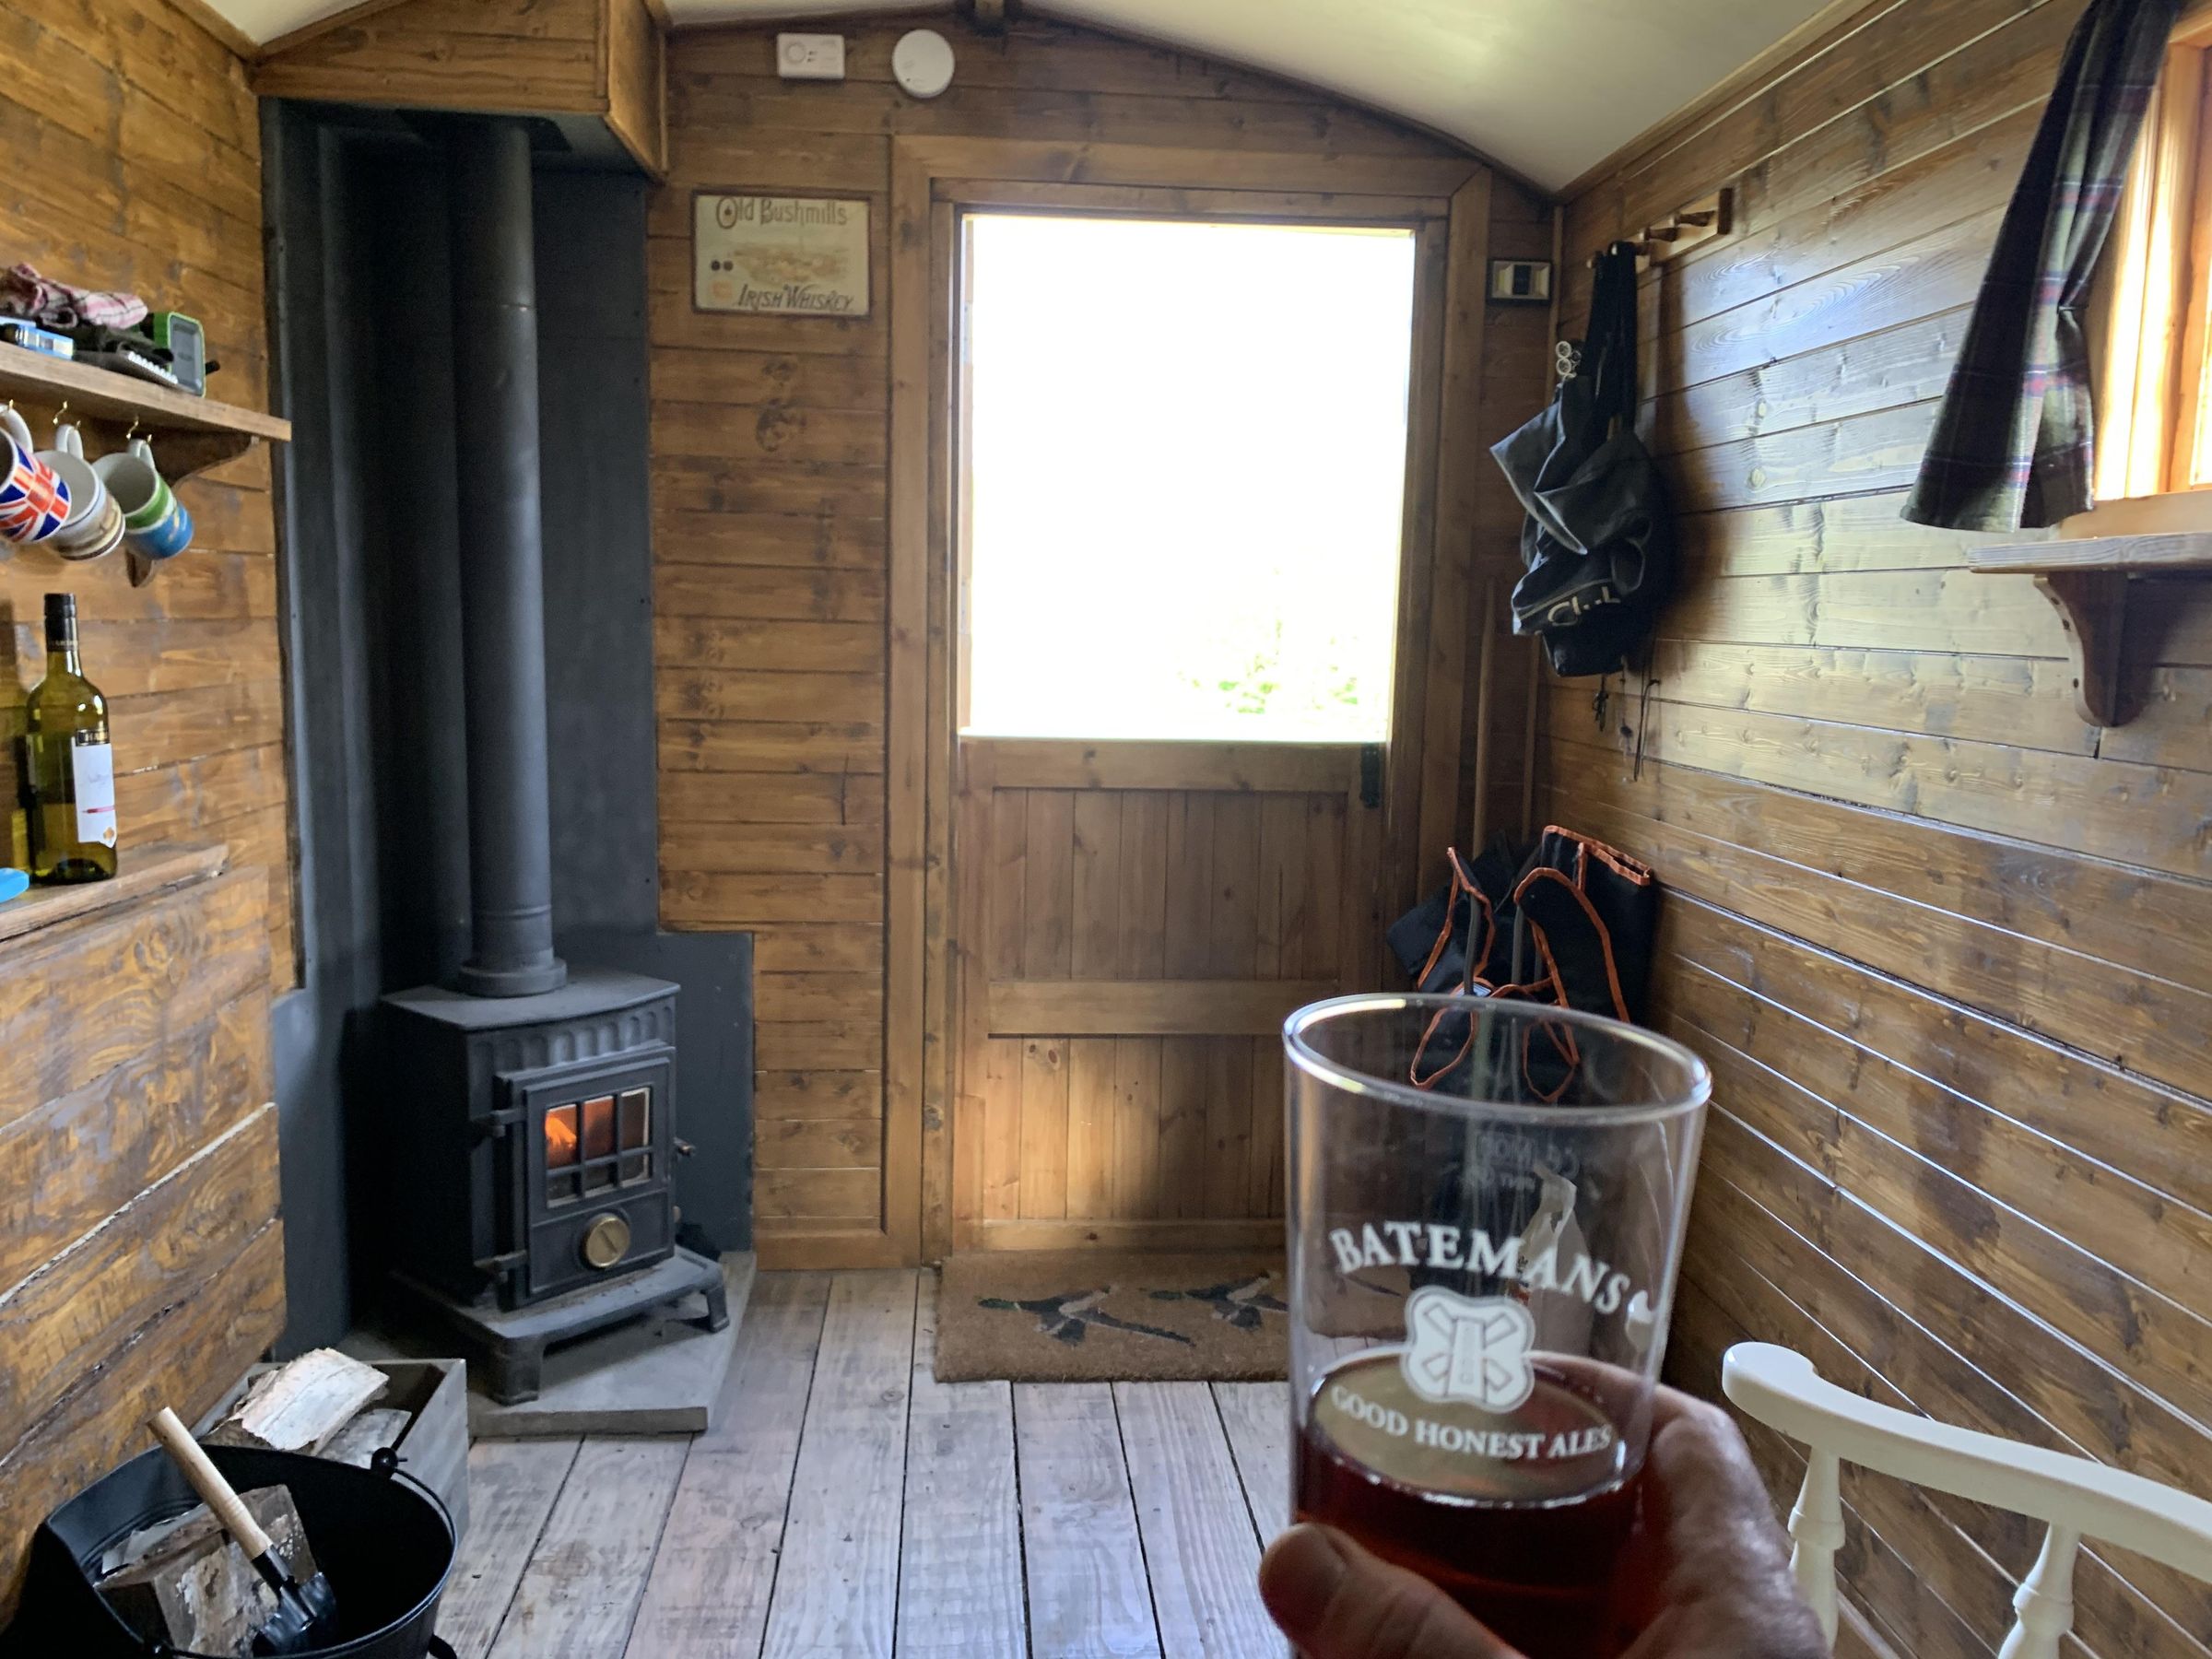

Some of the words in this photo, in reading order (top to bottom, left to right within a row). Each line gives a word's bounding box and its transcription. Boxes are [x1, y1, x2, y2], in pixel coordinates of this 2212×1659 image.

[715, 196, 755, 229] Old
[759, 197, 848, 226] Bushmills
[1328, 1219, 1631, 1315] BATEMANS
[1330, 1384, 1410, 1437] GOOD
[1414, 1418, 1547, 1460] HONEST
[1547, 1423, 1612, 1458] ALES
